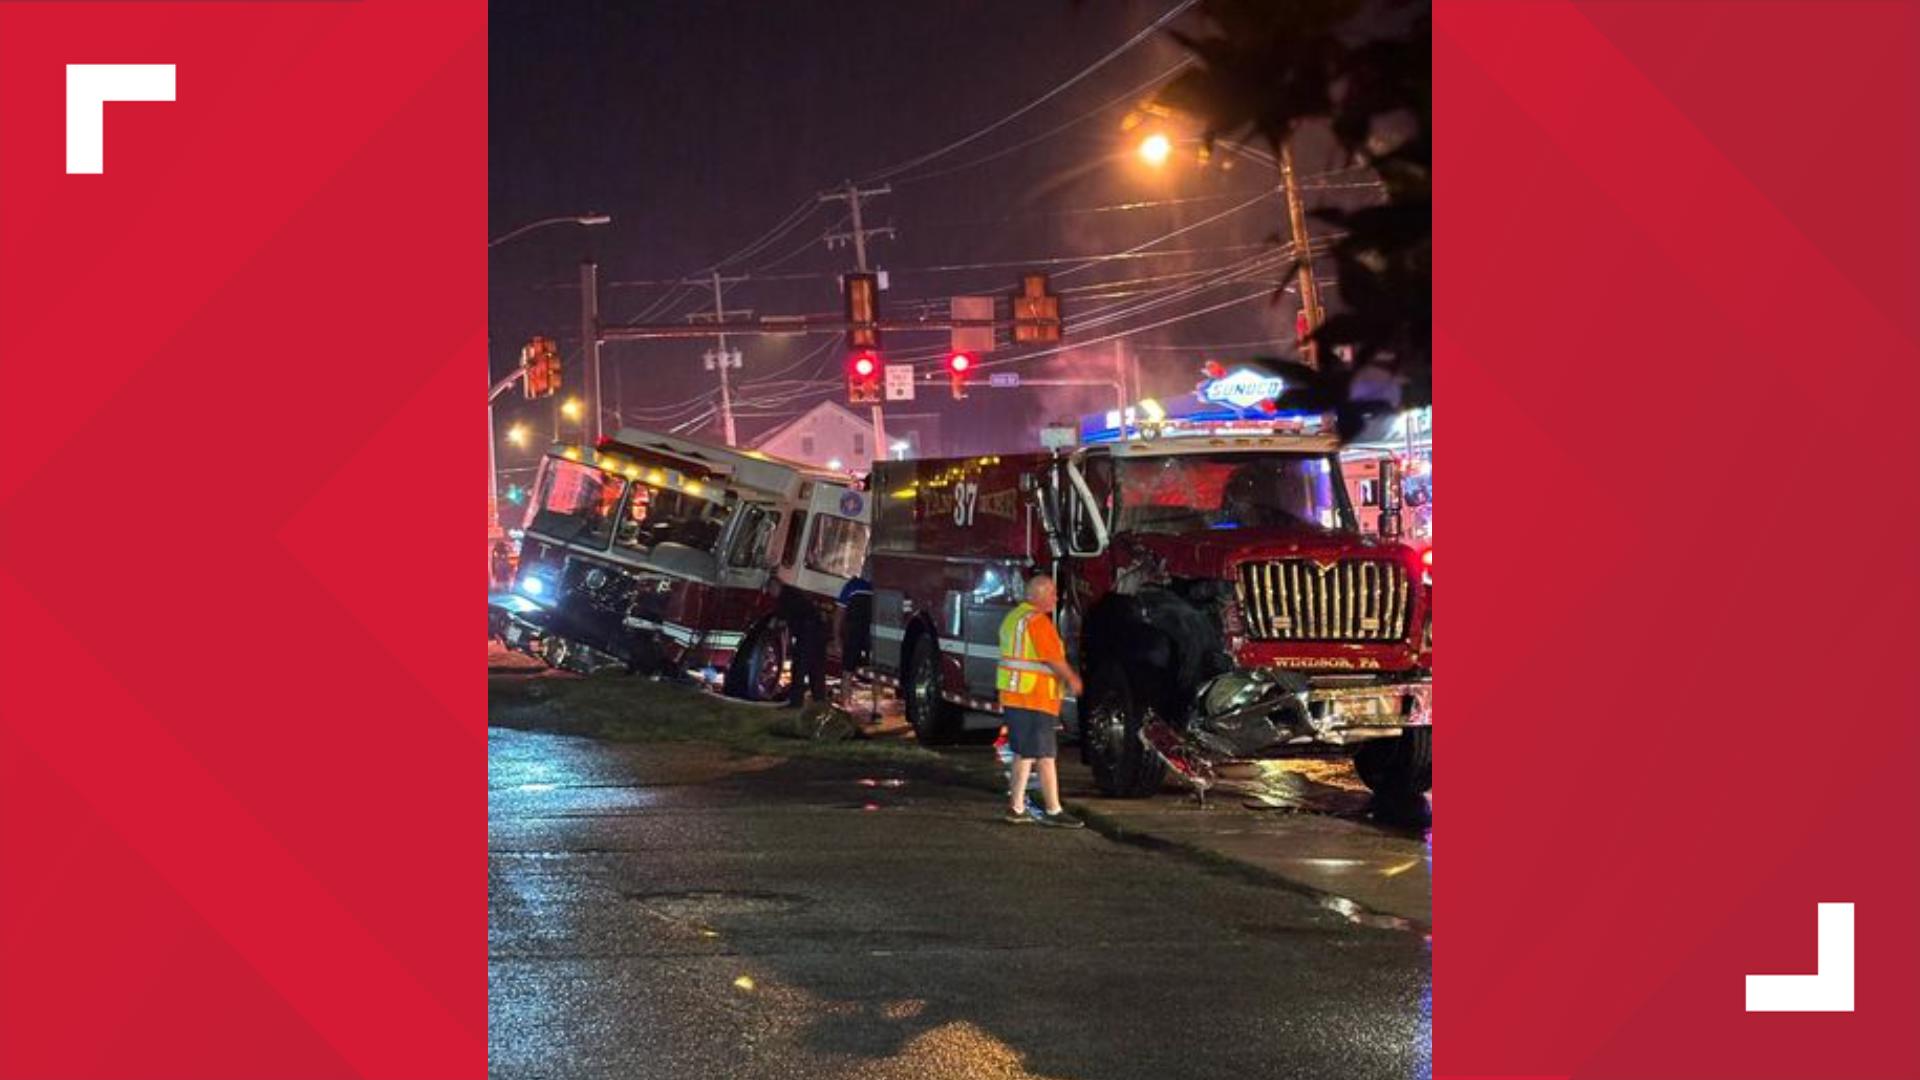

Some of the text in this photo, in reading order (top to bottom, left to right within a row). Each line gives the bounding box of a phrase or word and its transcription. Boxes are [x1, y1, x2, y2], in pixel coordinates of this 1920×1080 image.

[1211, 382, 1279, 396] SUNOCO
[954, 482, 978, 527] 37
[1359, 657, 1380, 669] PA
